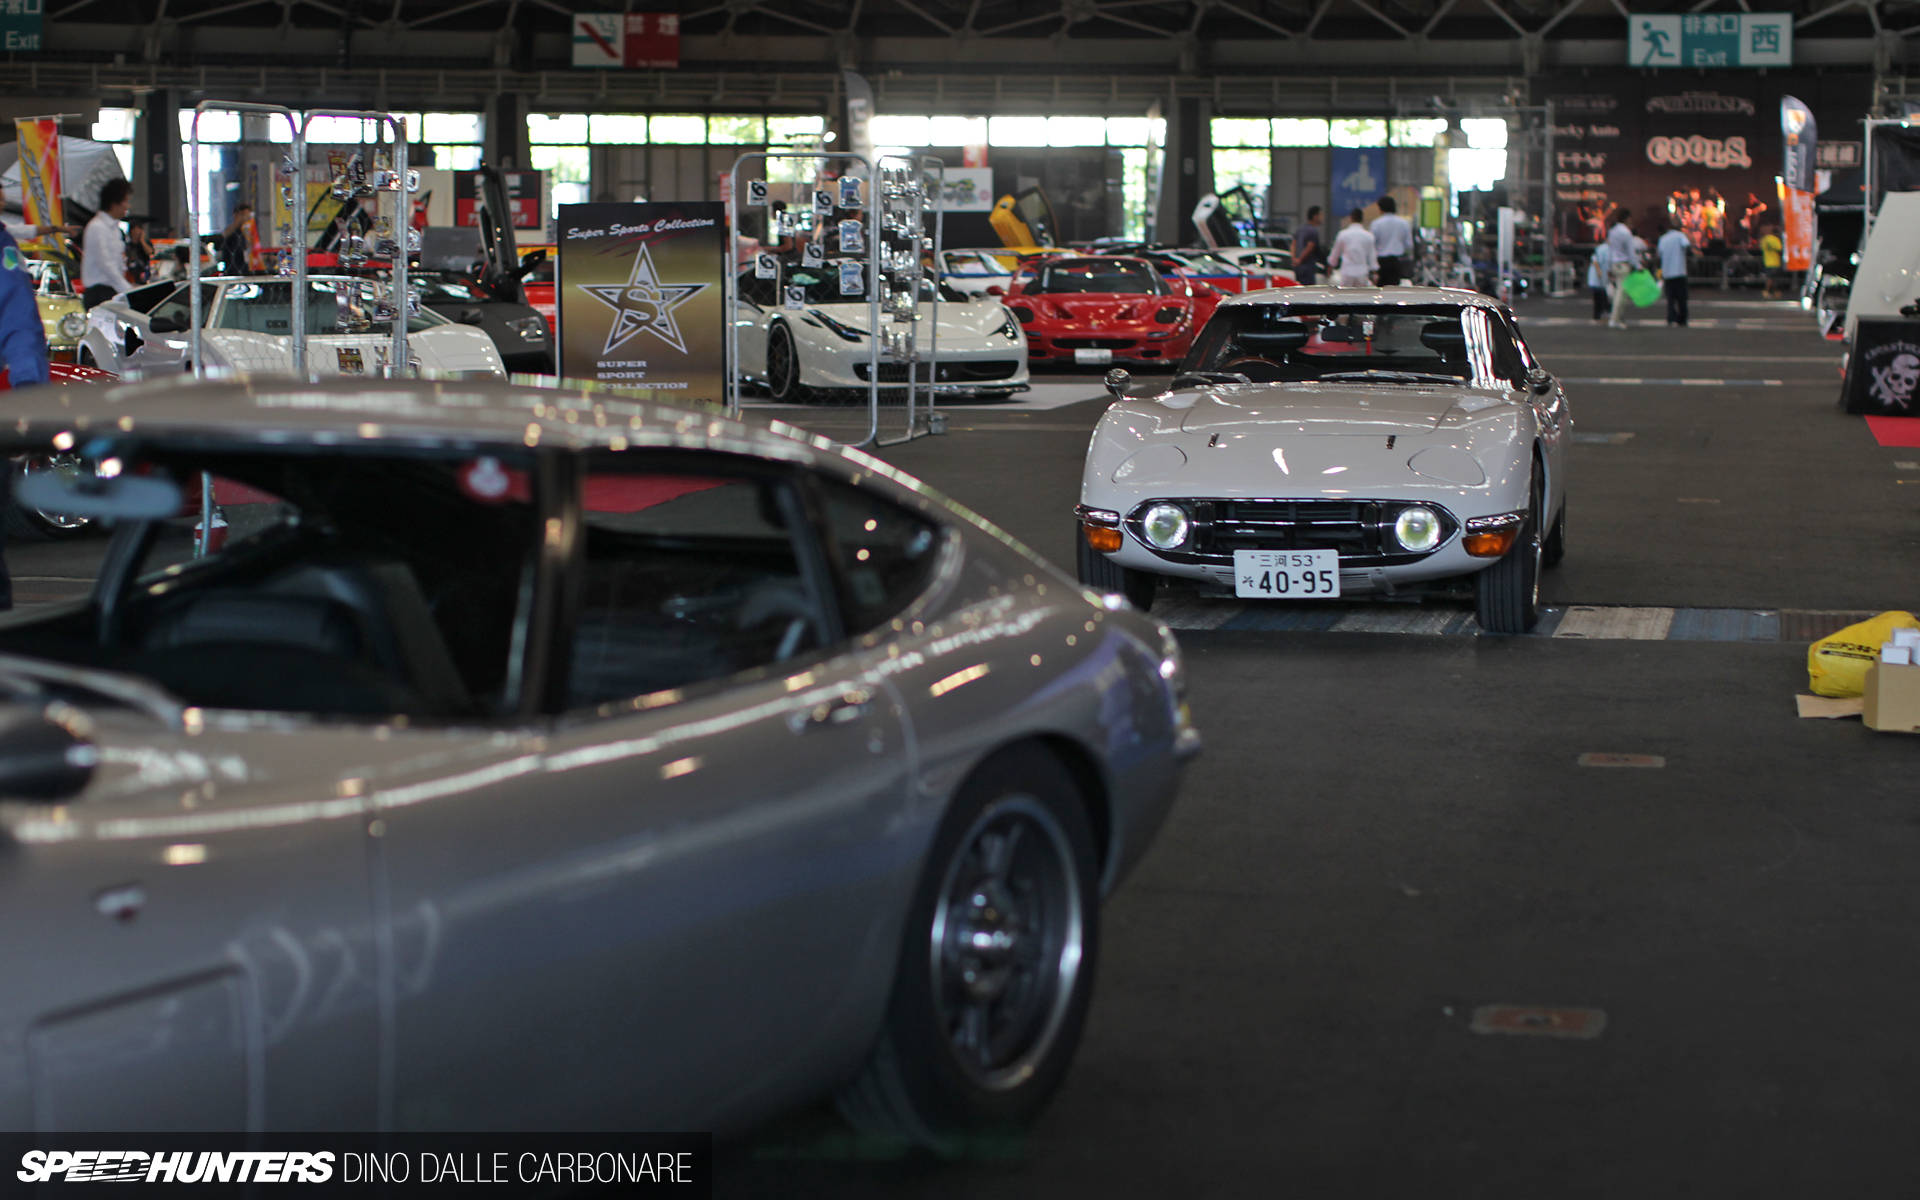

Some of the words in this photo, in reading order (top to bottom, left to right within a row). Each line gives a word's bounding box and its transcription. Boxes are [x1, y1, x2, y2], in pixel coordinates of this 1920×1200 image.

[6, 31, 39, 49] Exit
[1751, 24, 1781, 53] 西
[1693, 48, 1727, 66] Exit
[153, 154, 164, 173] 5
[566, 227, 604, 240] Super
[609, 223, 650, 236] Sports
[653, 218, 716, 233] Collection
[597, 360, 648, 369] SUPER
[597, 372, 646, 380] SPORT
[598, 382, 689, 390] COLLECTION
[1260, 554, 1288, 567] 三河
[1291, 554, 1314, 567] 53
[1259, 570, 1334, 594] 40-95
